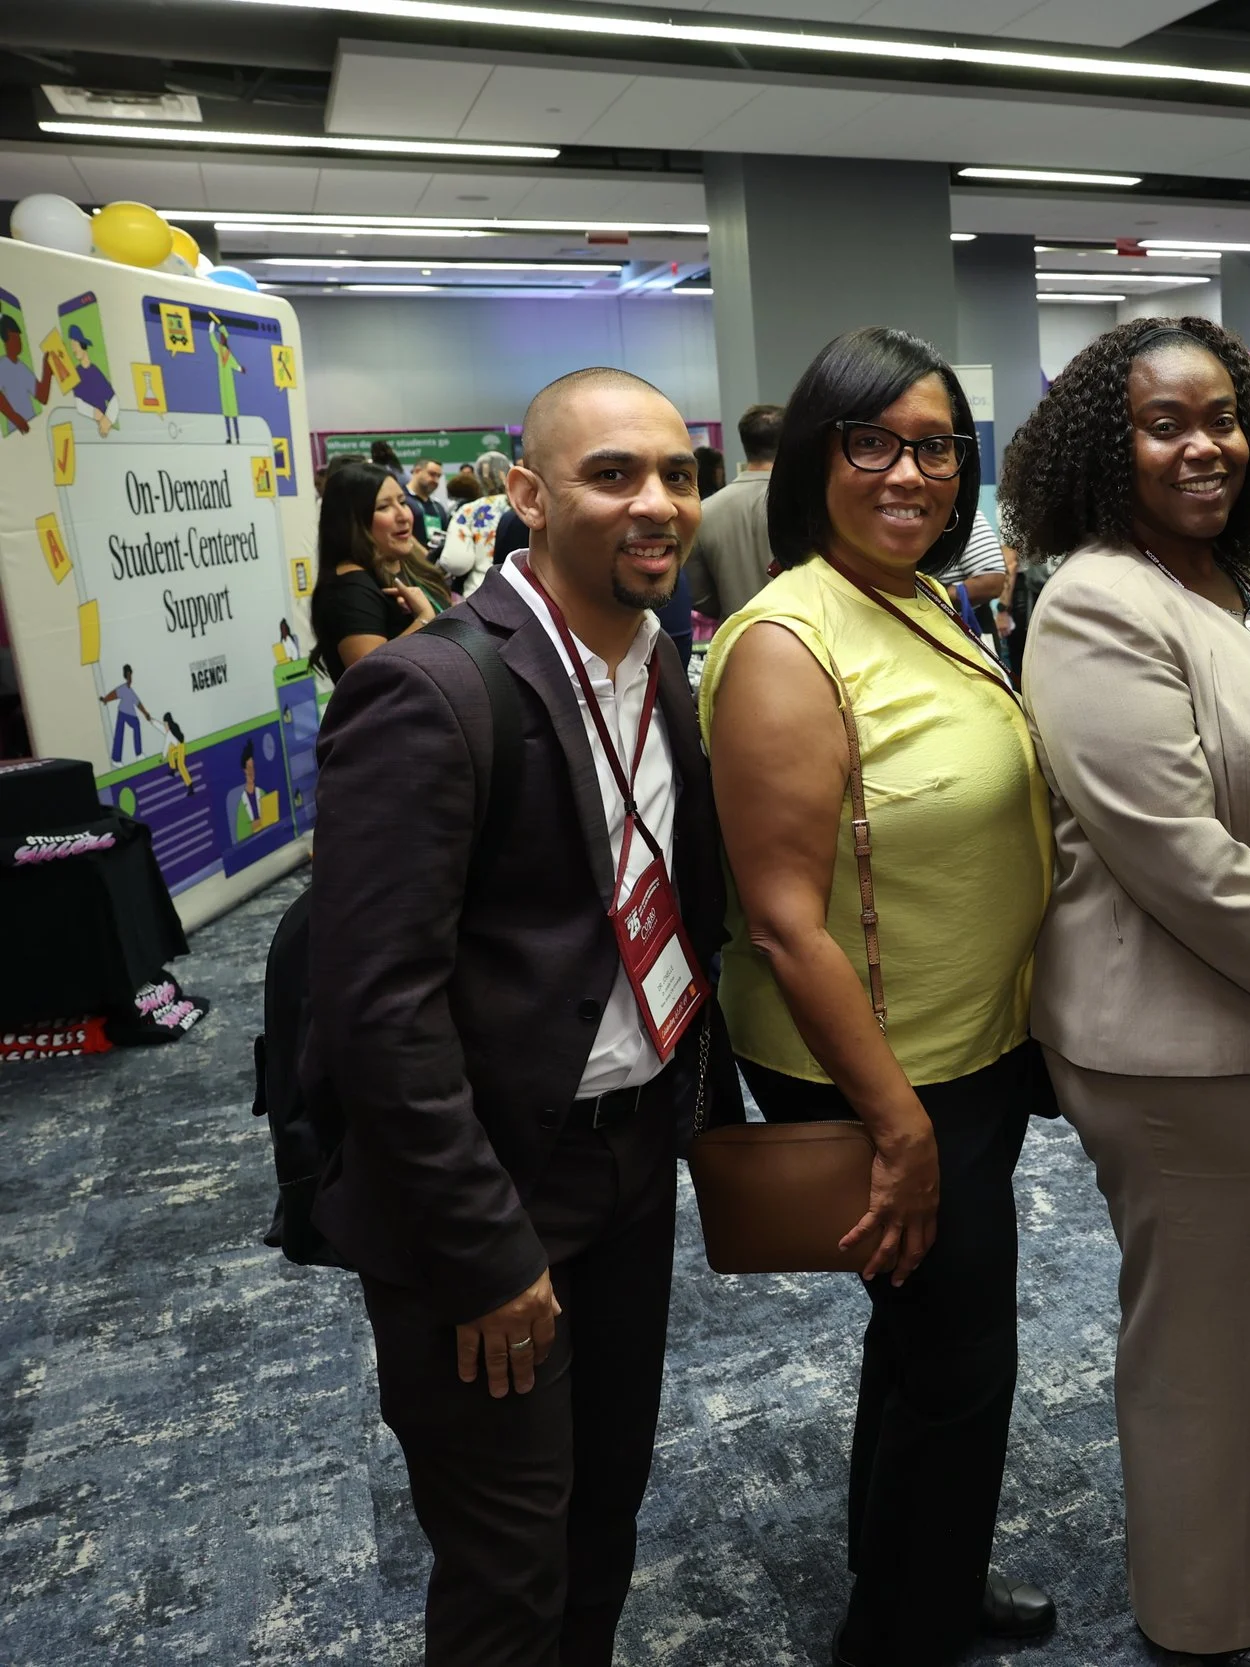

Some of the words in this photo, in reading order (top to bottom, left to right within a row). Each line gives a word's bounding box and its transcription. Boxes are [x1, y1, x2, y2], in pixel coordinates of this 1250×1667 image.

[125, 469, 232, 516] On-Demand
[108, 522, 259, 581] Student-Centered
[163, 584, 234, 638] Support
[190, 664, 228, 693] AGENCY
